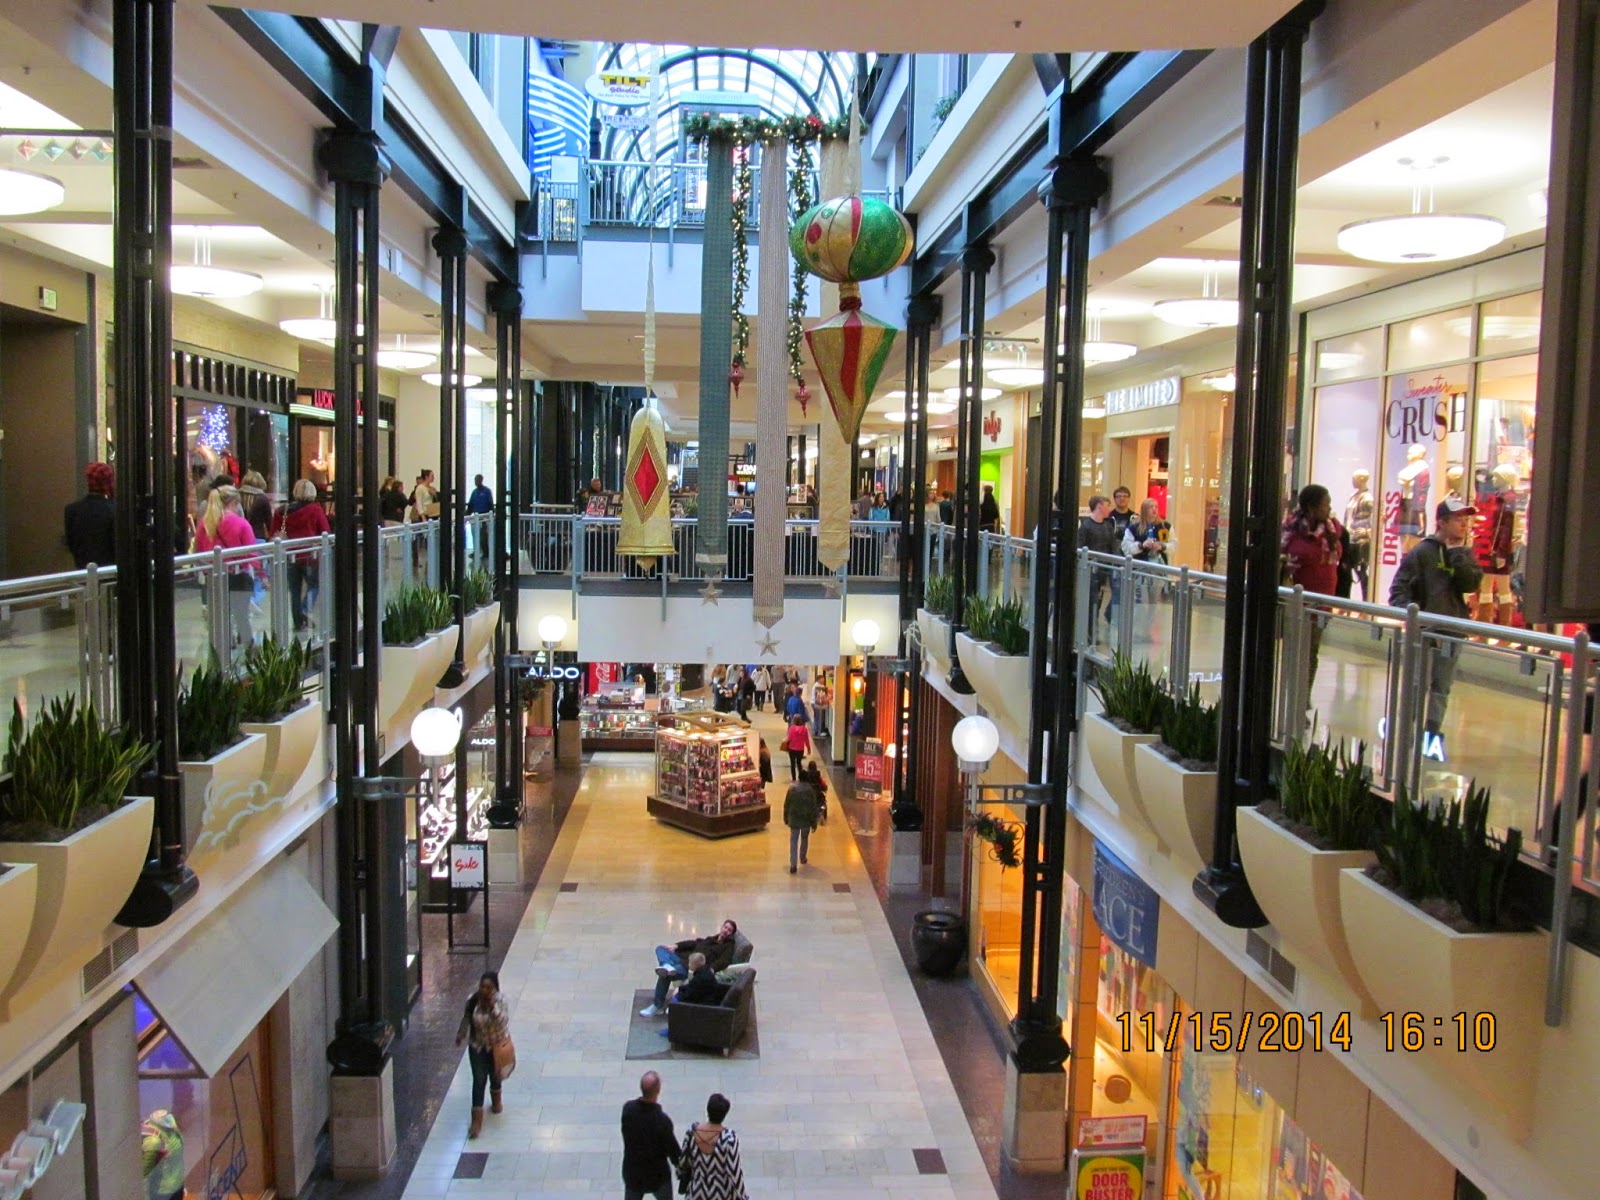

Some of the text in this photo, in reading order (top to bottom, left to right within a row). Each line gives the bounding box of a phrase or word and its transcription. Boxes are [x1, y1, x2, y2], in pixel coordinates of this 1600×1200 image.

[600, 74, 650, 89] TILT
[609, 86, 640, 95] Studio
[1128, 378, 1178, 410] LIMITED
[1405, 374, 1452, 399] Sweater
[1386, 391, 1467, 445] CRUSH
[1382, 491, 1402, 566] DRESS
[526, 666, 580, 679] ALDO
[864, 743, 877, 752] SALE
[455, 856, 479, 873] Sale
[1091, 1172, 1129, 1187] DOOR
[1085, 1187, 1134, 1200] BUSTER
